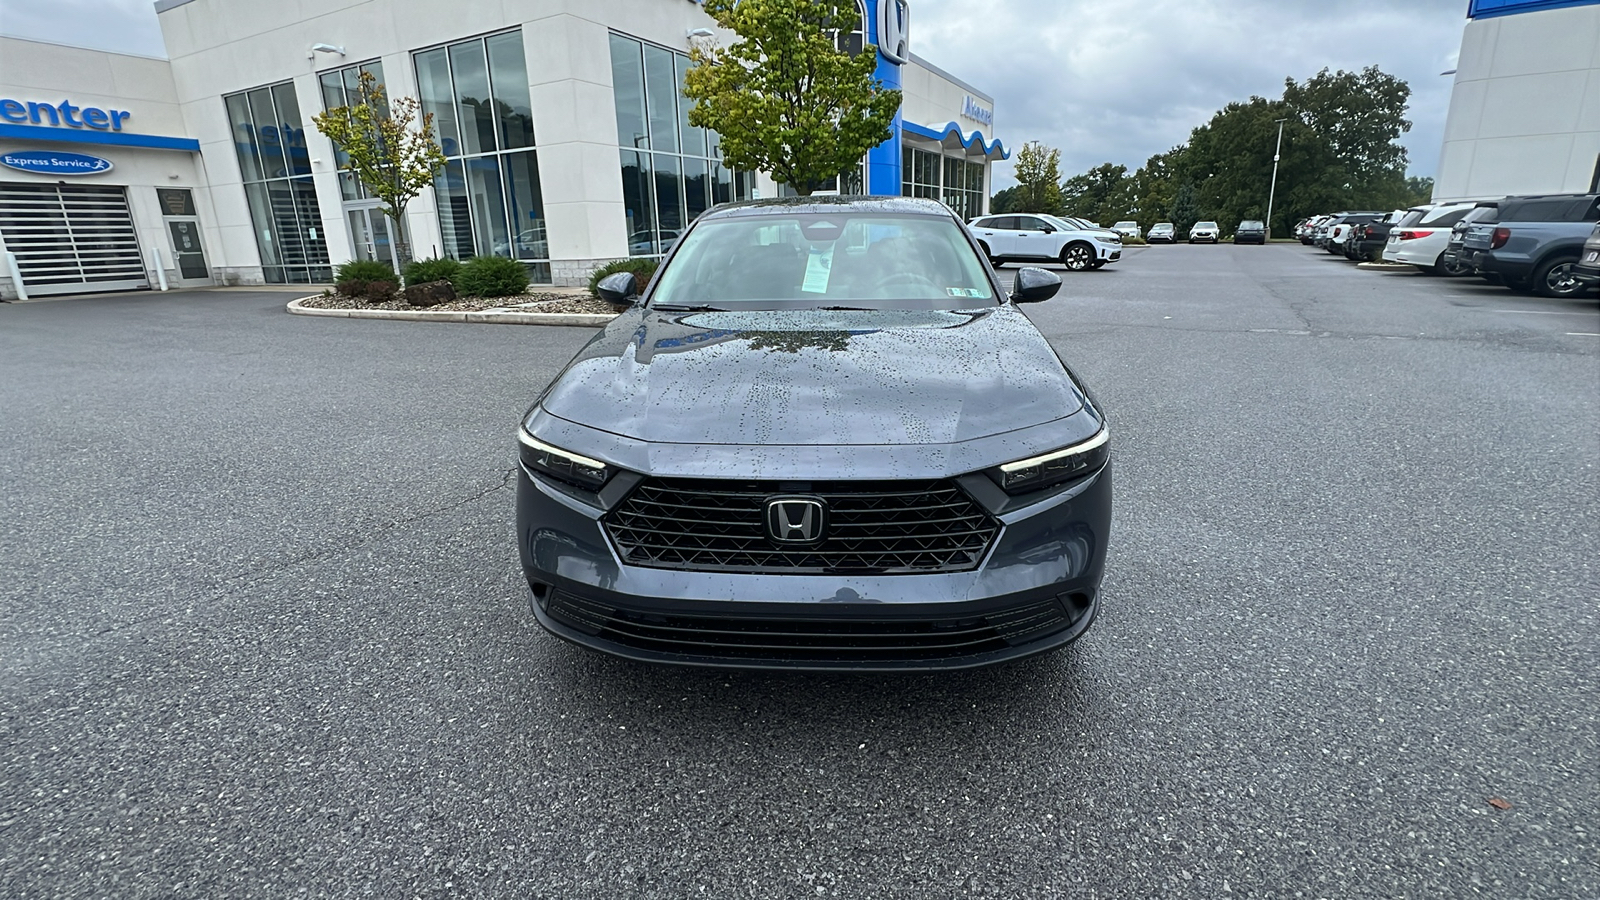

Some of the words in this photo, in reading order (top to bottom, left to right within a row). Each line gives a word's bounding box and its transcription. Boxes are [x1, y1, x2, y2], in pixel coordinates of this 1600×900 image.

[0, 99, 130, 131] enter
[4, 156, 49, 167] Express
[51, 159, 91, 168] Service
